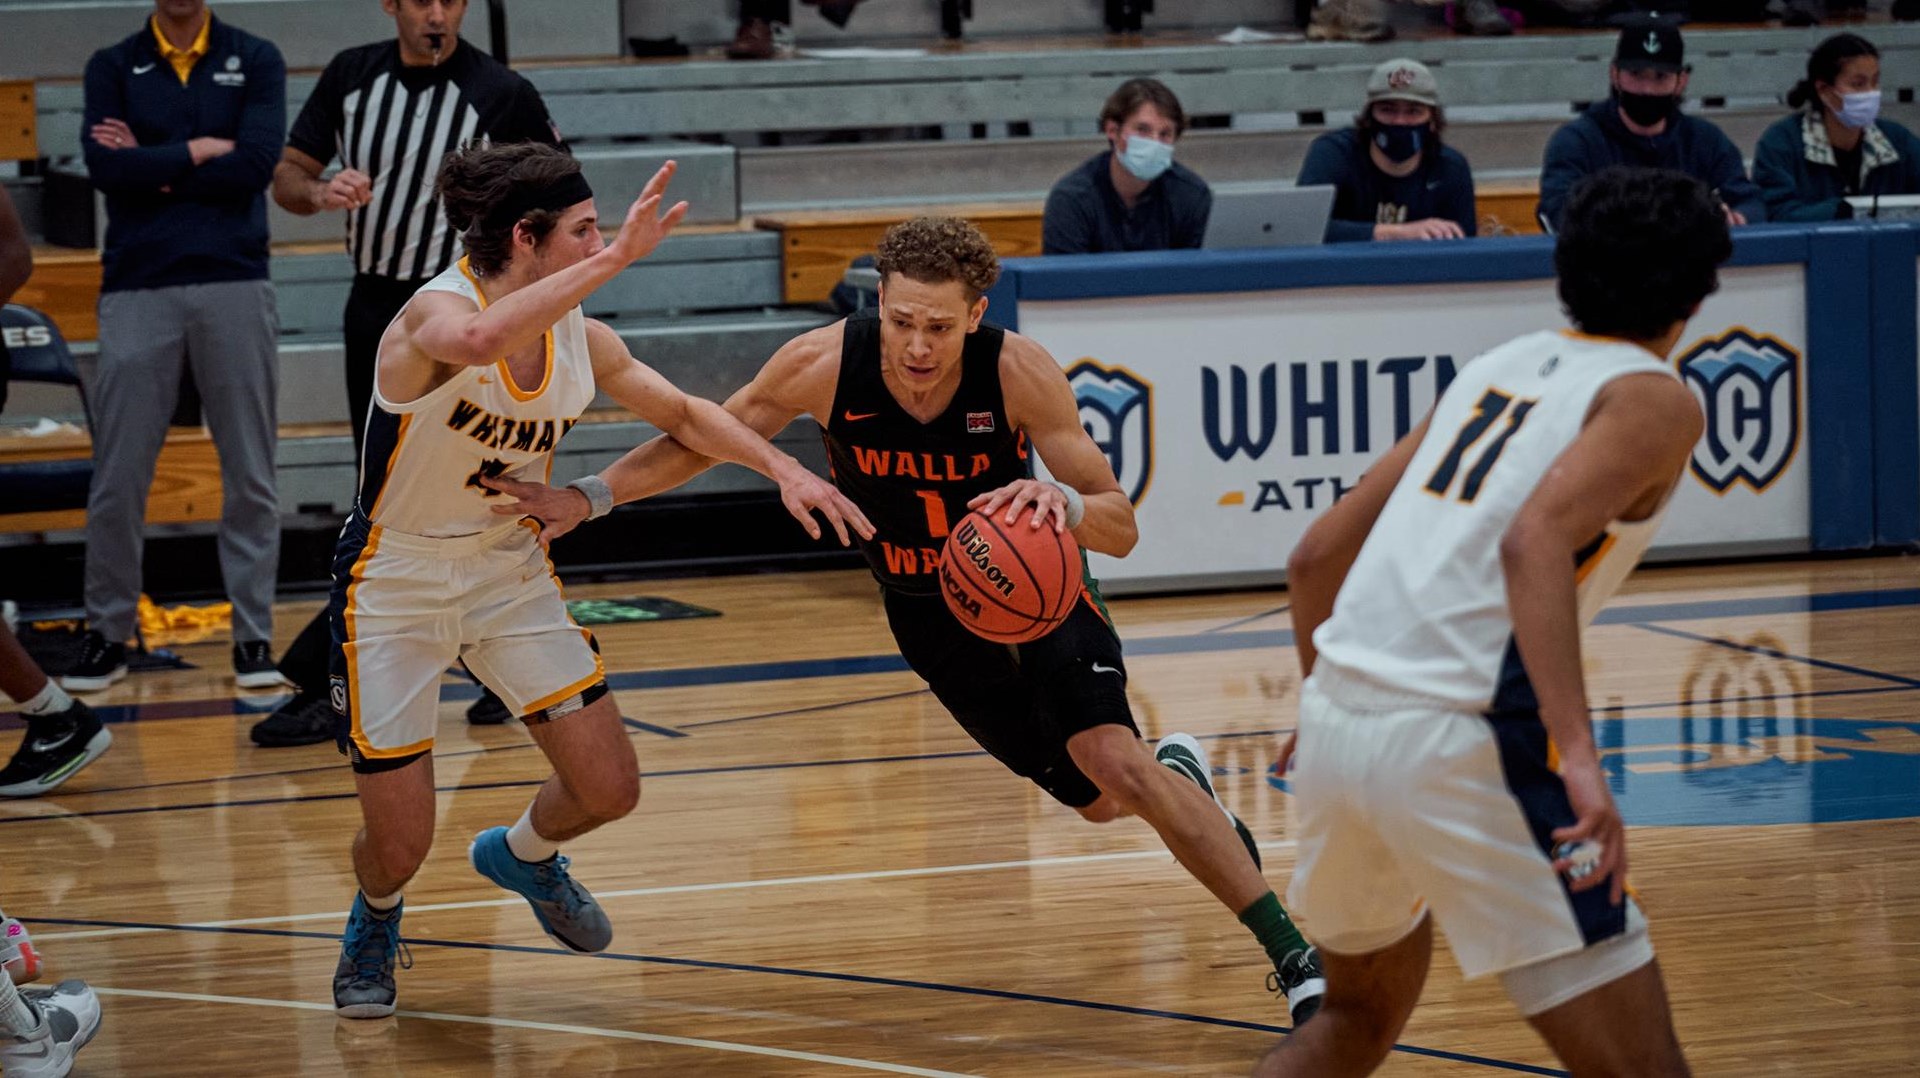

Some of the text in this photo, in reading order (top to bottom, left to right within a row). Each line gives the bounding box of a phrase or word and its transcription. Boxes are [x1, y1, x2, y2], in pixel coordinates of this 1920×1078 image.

[852, 445, 991, 481] WALLA
[1420, 385, 1540, 506] 11
[916, 490, 951, 538] 1
[956, 520, 1017, 599] Wilson
[940, 560, 983, 620] NCAA
